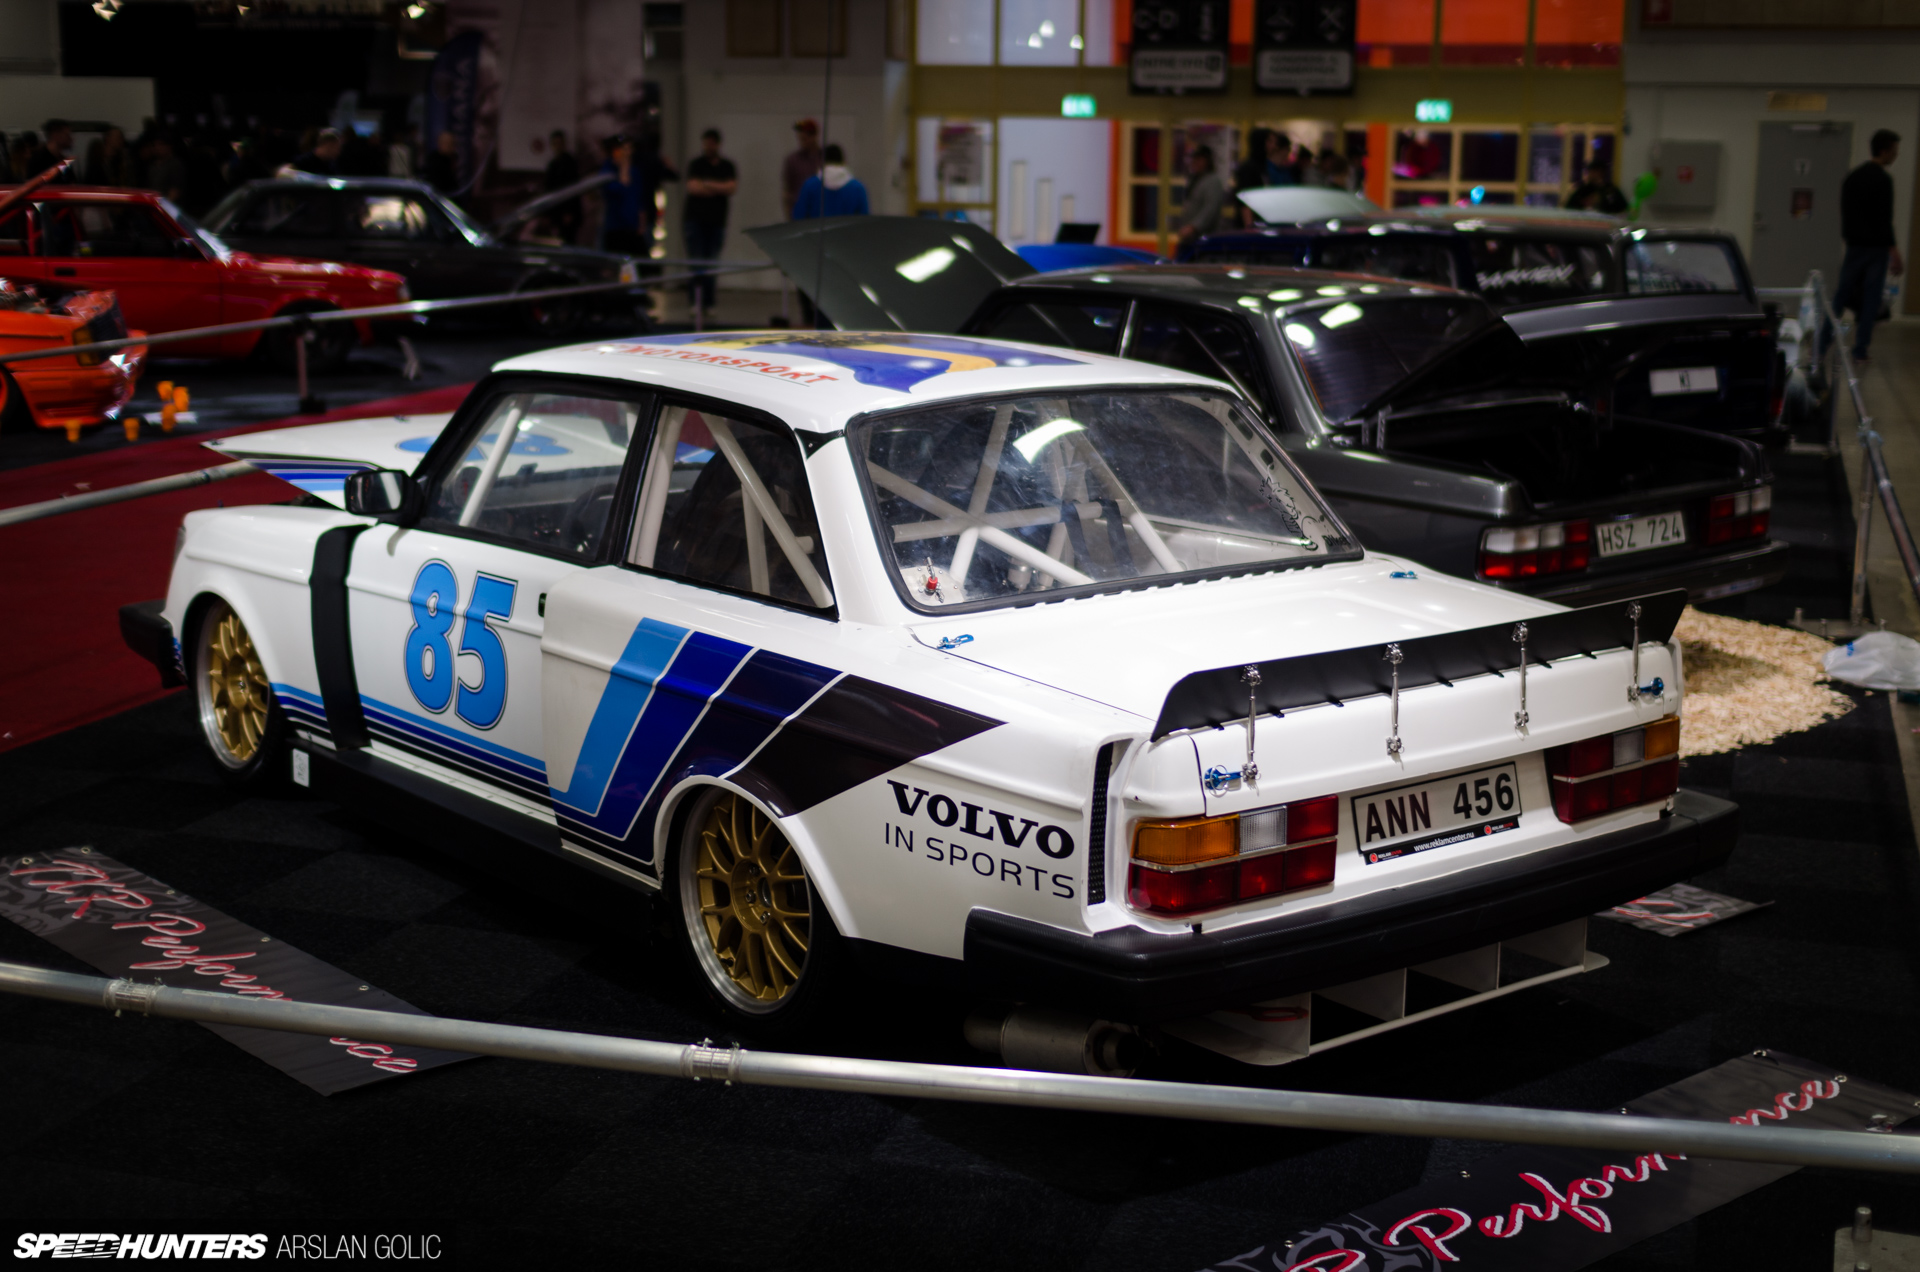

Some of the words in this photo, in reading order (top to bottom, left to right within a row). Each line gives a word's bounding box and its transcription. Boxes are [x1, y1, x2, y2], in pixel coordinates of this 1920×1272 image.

[1600, 523, 1637, 553] HSZ
[1647, 515, 1681, 544] 724
[403, 557, 519, 732] 85
[887, 778, 1075, 860] VOLVO
[1365, 791, 1432, 843] ANN
[1453, 772, 1514, 820] 456
[1414, 831, 1475, 852] www.reklamcenter.nu
[885, 822, 914, 853] IN
[925, 837, 1075, 899] SPORTS
